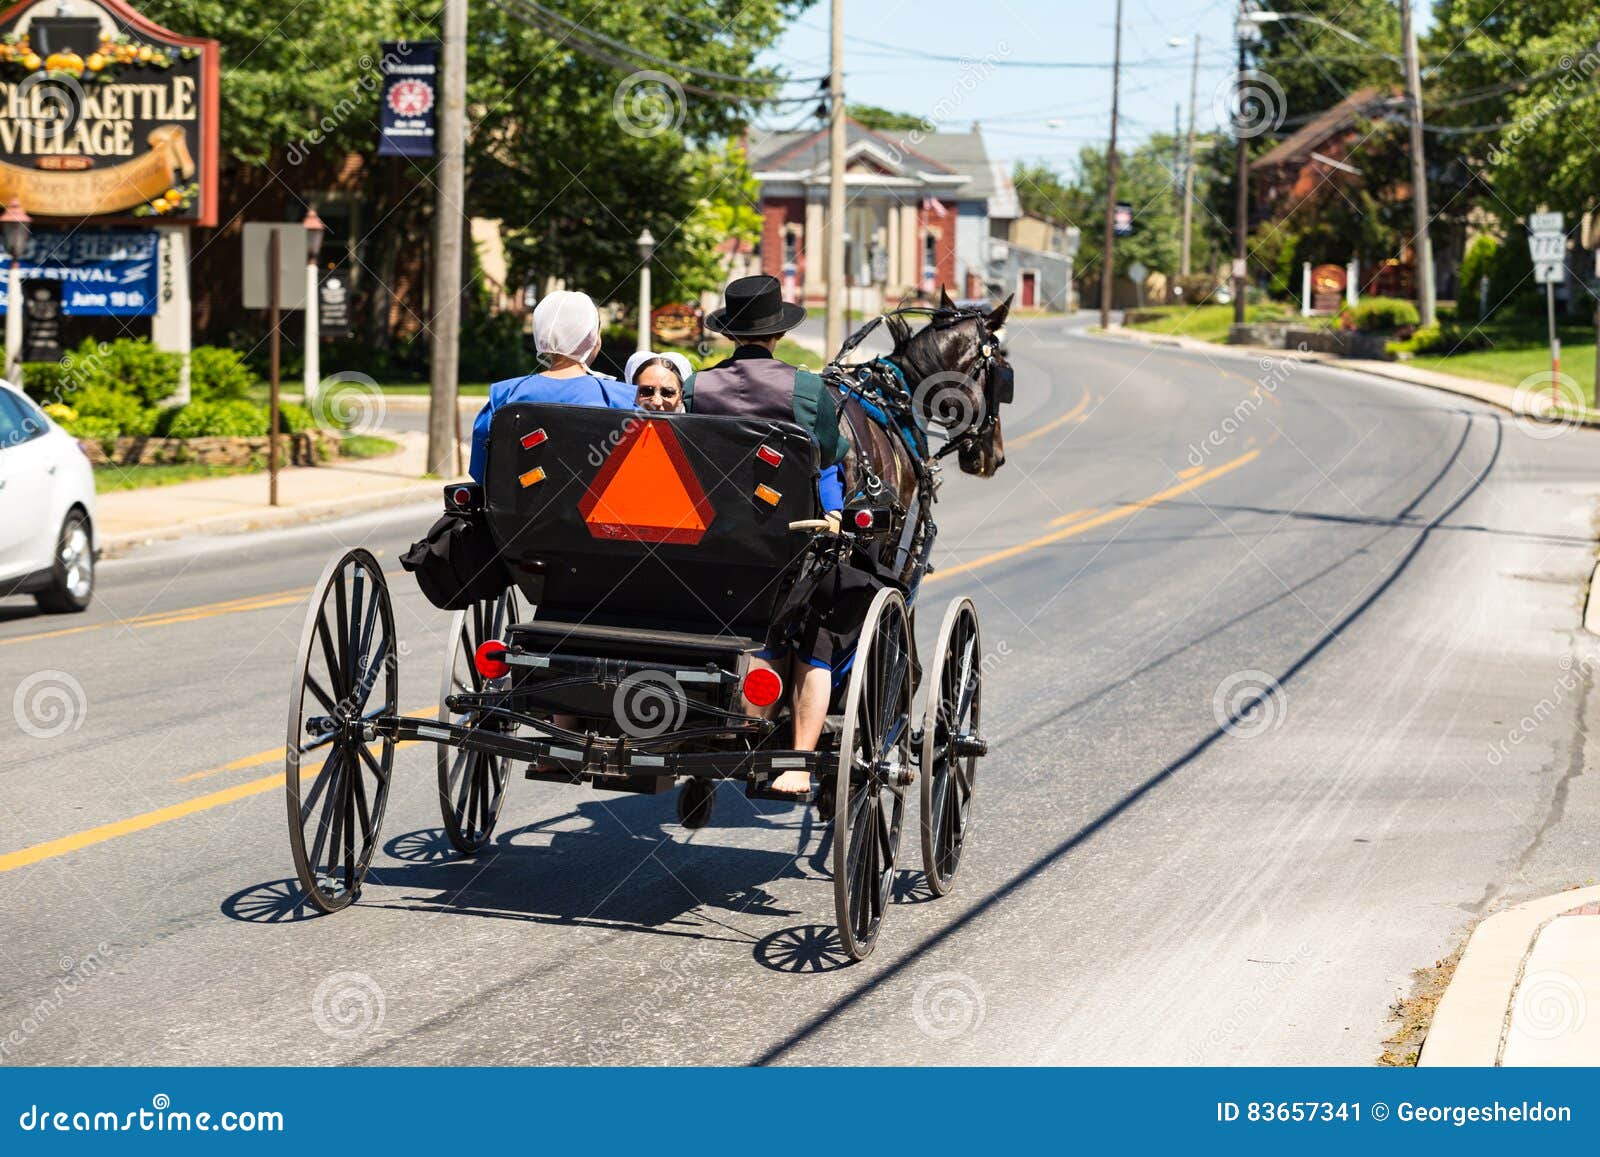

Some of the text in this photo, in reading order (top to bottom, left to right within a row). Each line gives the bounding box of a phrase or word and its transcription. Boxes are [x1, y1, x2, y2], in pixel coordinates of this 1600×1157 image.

[80, 76, 196, 120] KETTLE
[0, 118, 134, 155] VILLAGE
[1534, 237, 1561, 255] 772
